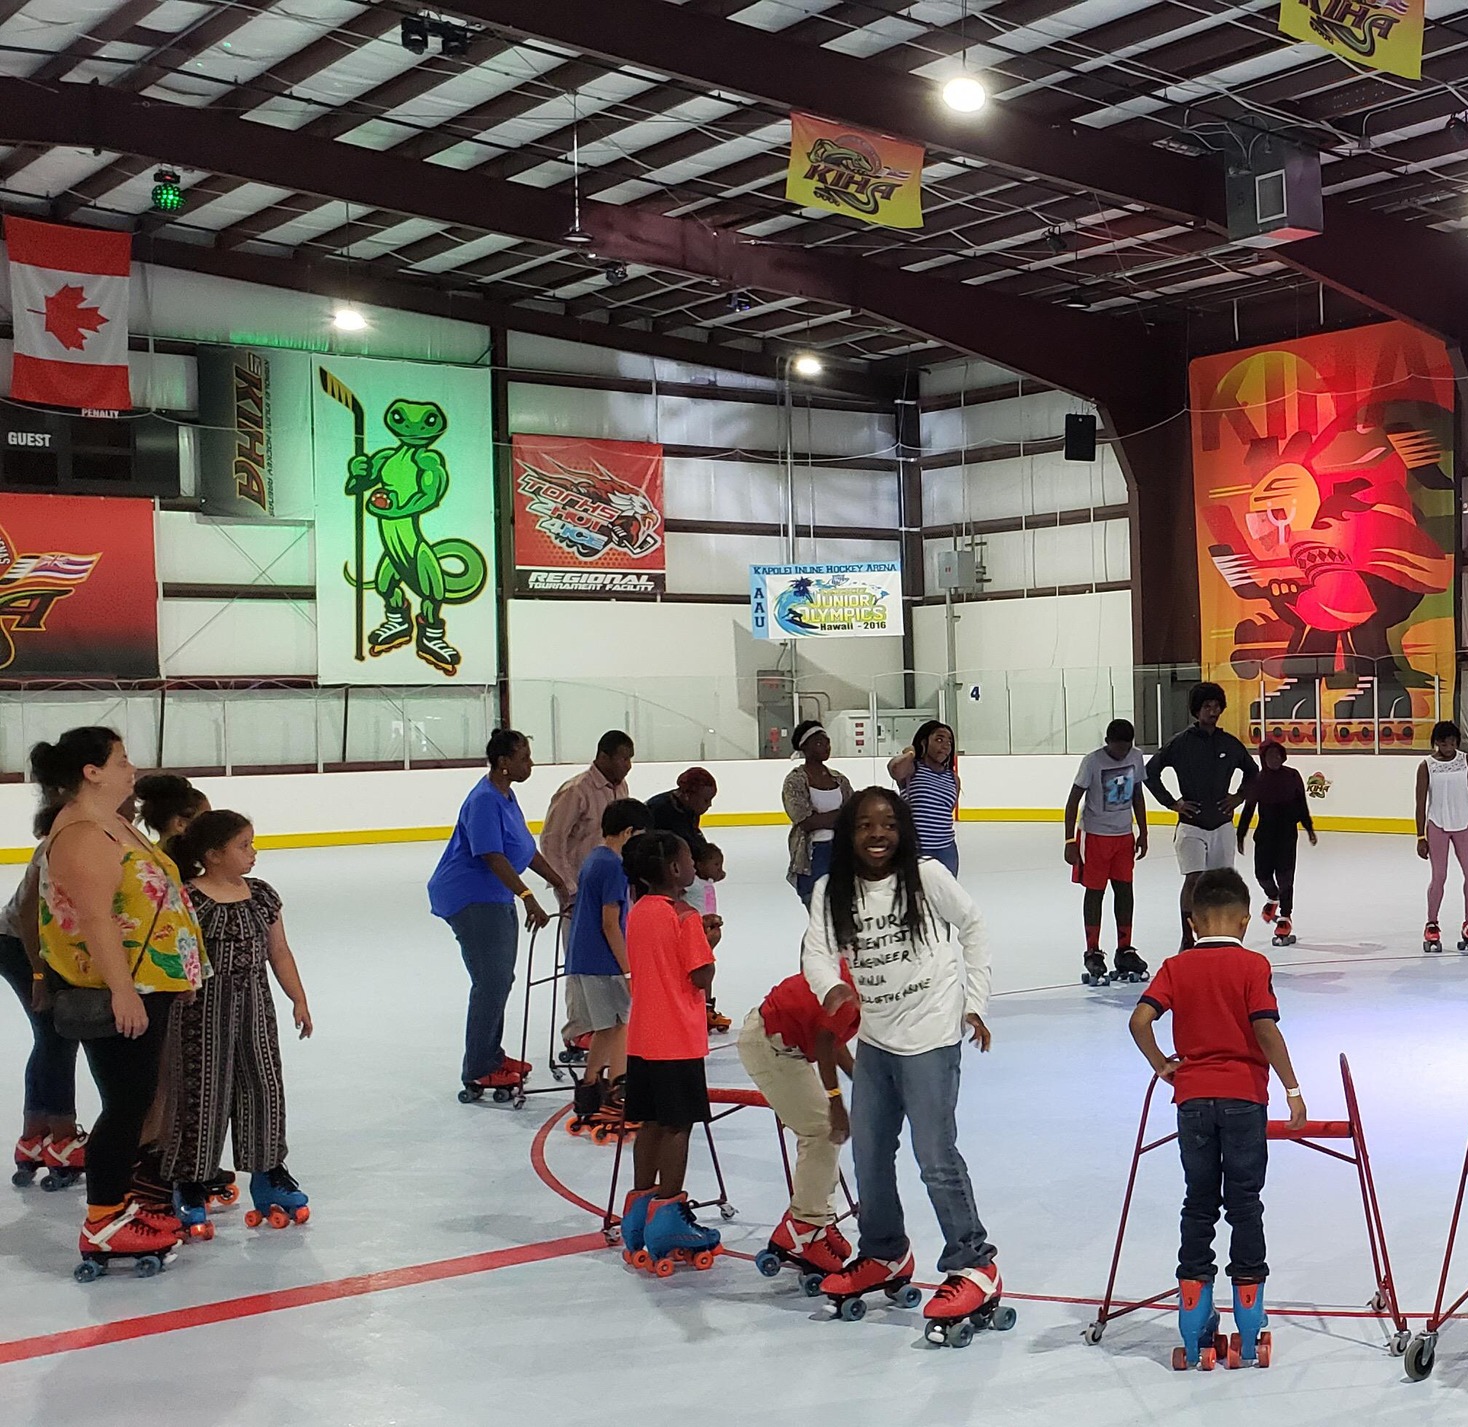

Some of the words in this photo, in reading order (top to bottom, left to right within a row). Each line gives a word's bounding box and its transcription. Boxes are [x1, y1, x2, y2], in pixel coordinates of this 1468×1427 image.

[803, 164, 902, 201] KIHA
[1200, 338, 1438, 451] KIHA
[82, 408, 120, 419] PENALTY
[8, 432, 51, 447] GUEST
[233, 363, 267, 512] KIHA
[754, 566, 792, 575] KAPOLEI
[795, 566, 824, 574] INLINE
[826, 565, 863, 573] HOCKEY
[866, 564, 896, 572] ARENA
[529, 572, 654, 585] REGIONAL
[529, 582, 603, 591] TOURNAMENT
[605, 584, 654, 592] FACILITY
[754, 588, 765, 628] AAU
[811, 593, 870, 608] JUNIOR
[800, 605, 885, 622] OLYMPICS
[820, 623, 853, 631] Hawaii
[863, 621, 886, 630] 2016
[971, 686, 980, 701] 4
